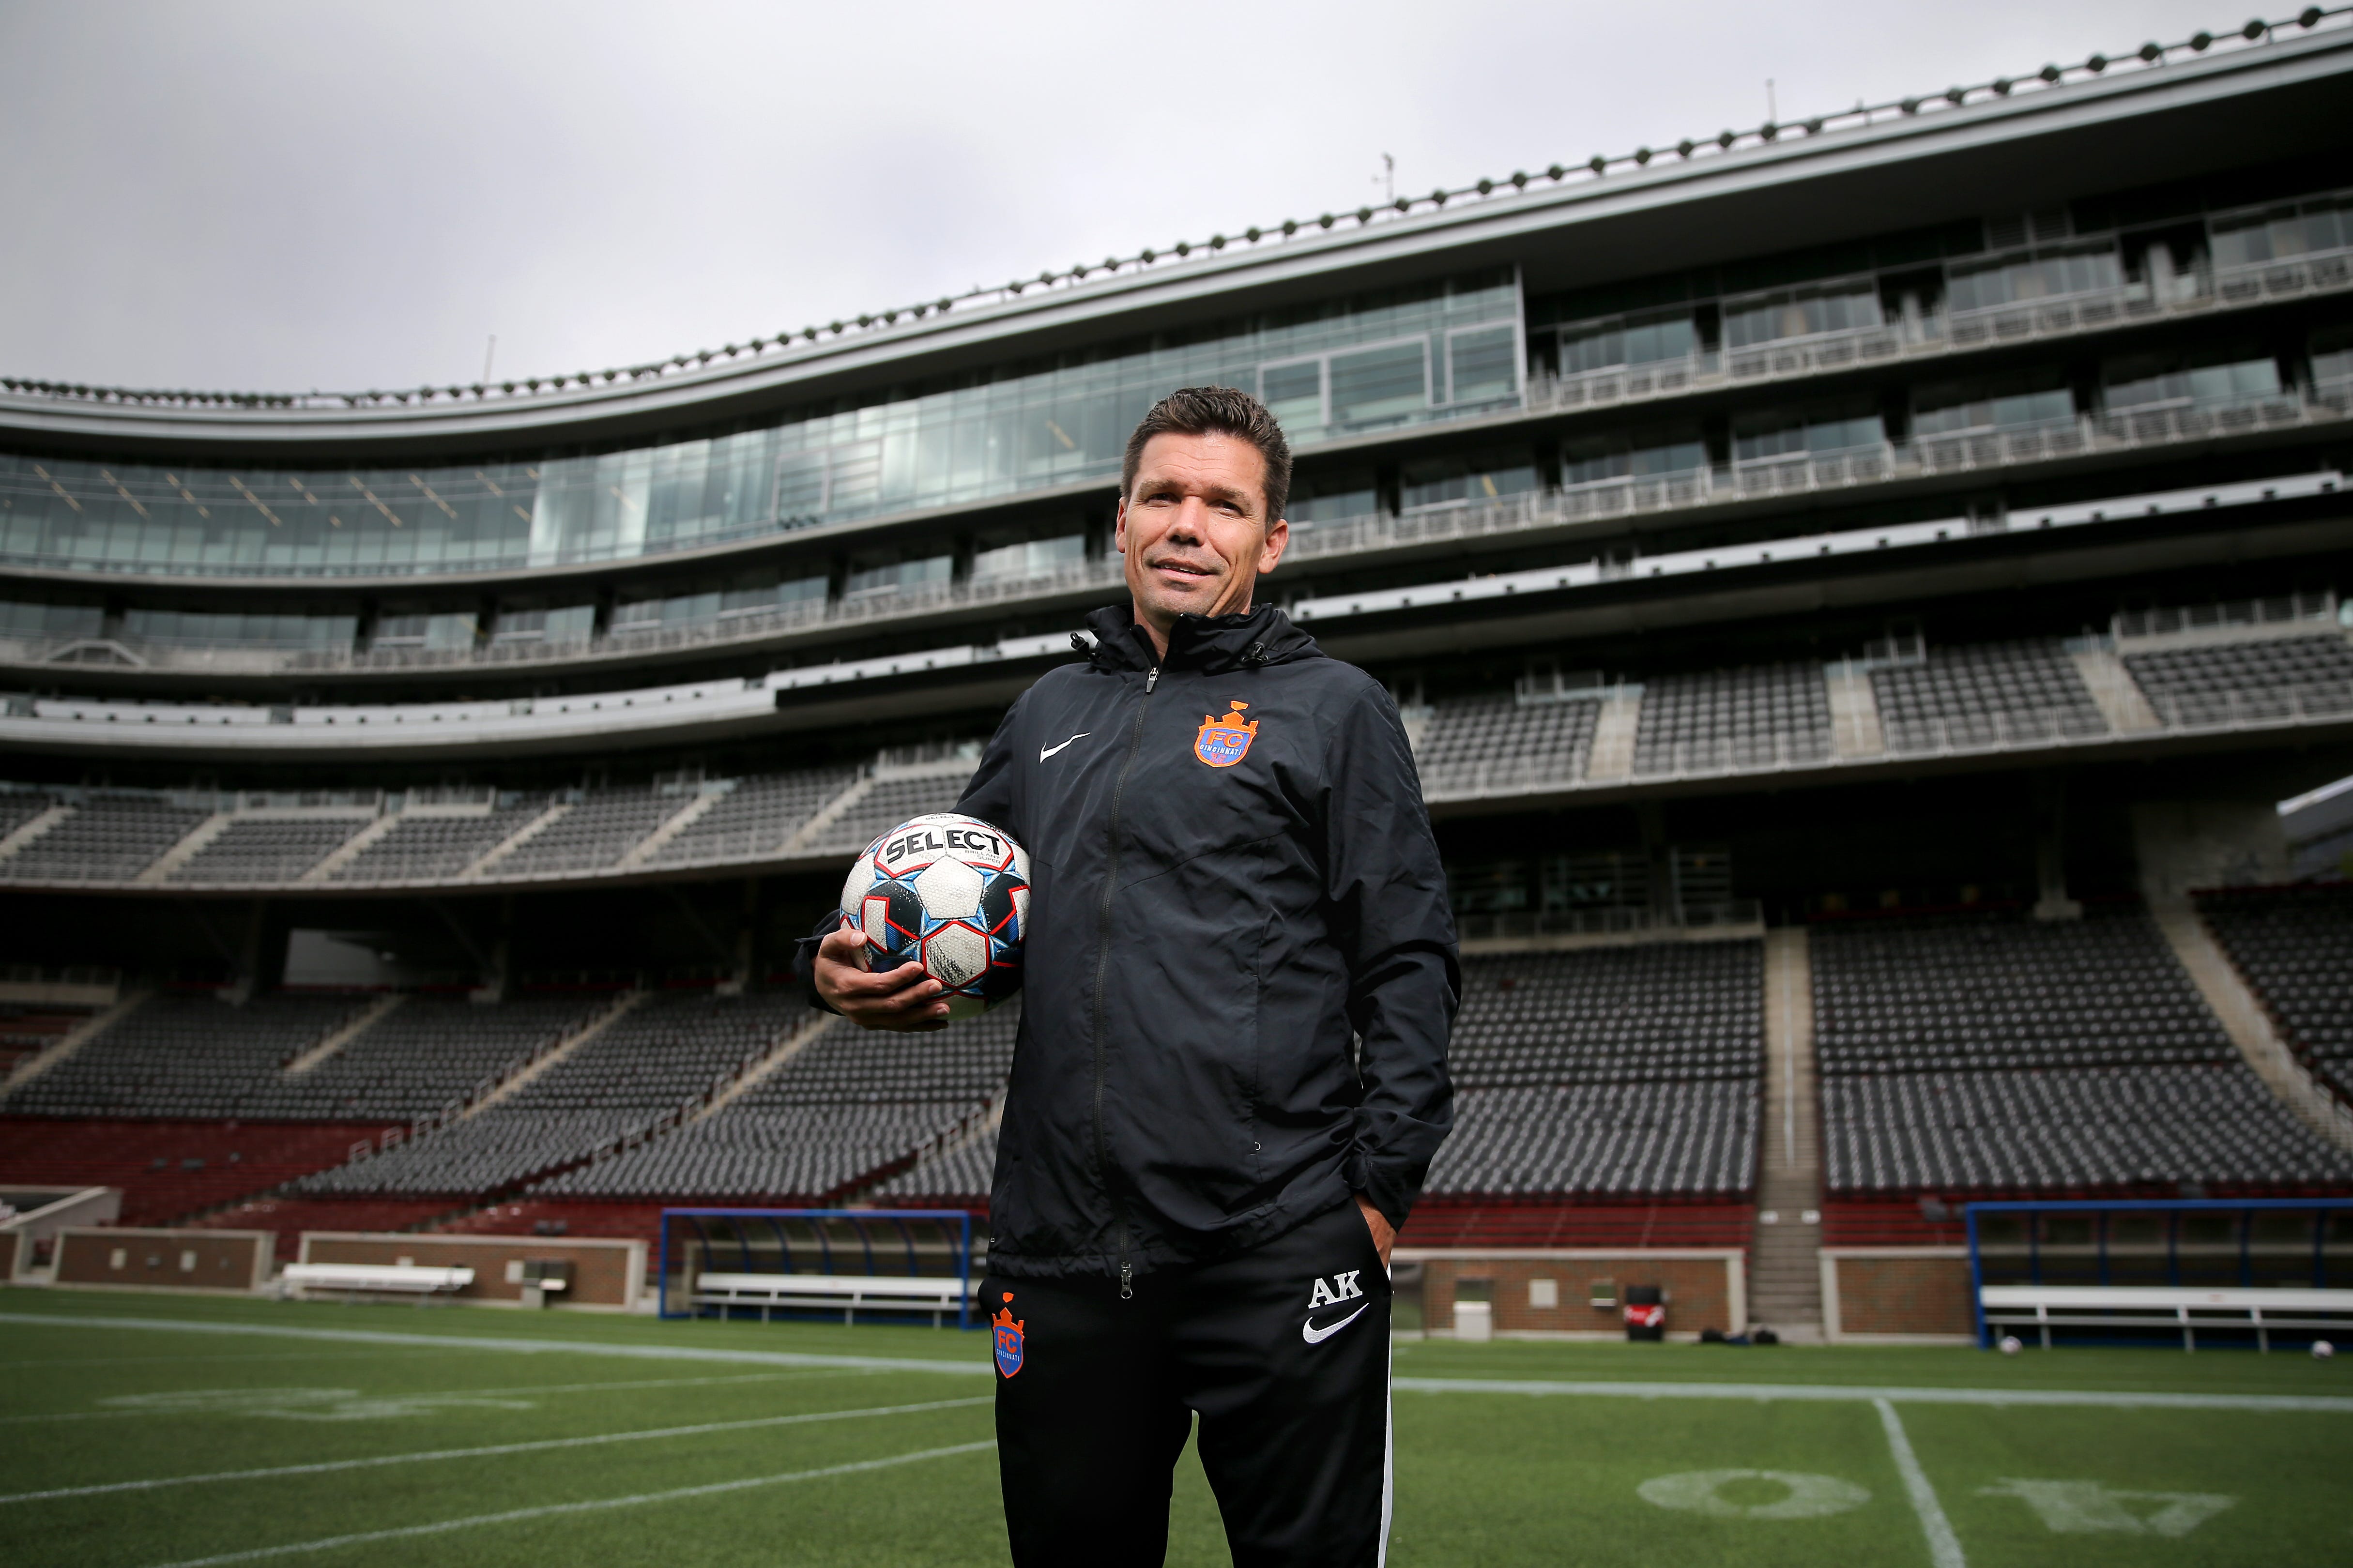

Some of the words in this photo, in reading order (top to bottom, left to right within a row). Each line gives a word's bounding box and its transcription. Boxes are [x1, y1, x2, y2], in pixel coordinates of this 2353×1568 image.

[1207, 731, 1244, 748] FC
[1199, 744, 1242, 756] CINCINNATI
[886, 830, 999, 864] SELECT
[965, 850, 1000, 860] BRILLANT
[977, 855, 1001, 865] SUPER
[1308, 1270, 1363, 1309] AK
[998, 1330, 1017, 1354] FC
[997, 1349, 1020, 1362] CINCINNATI
